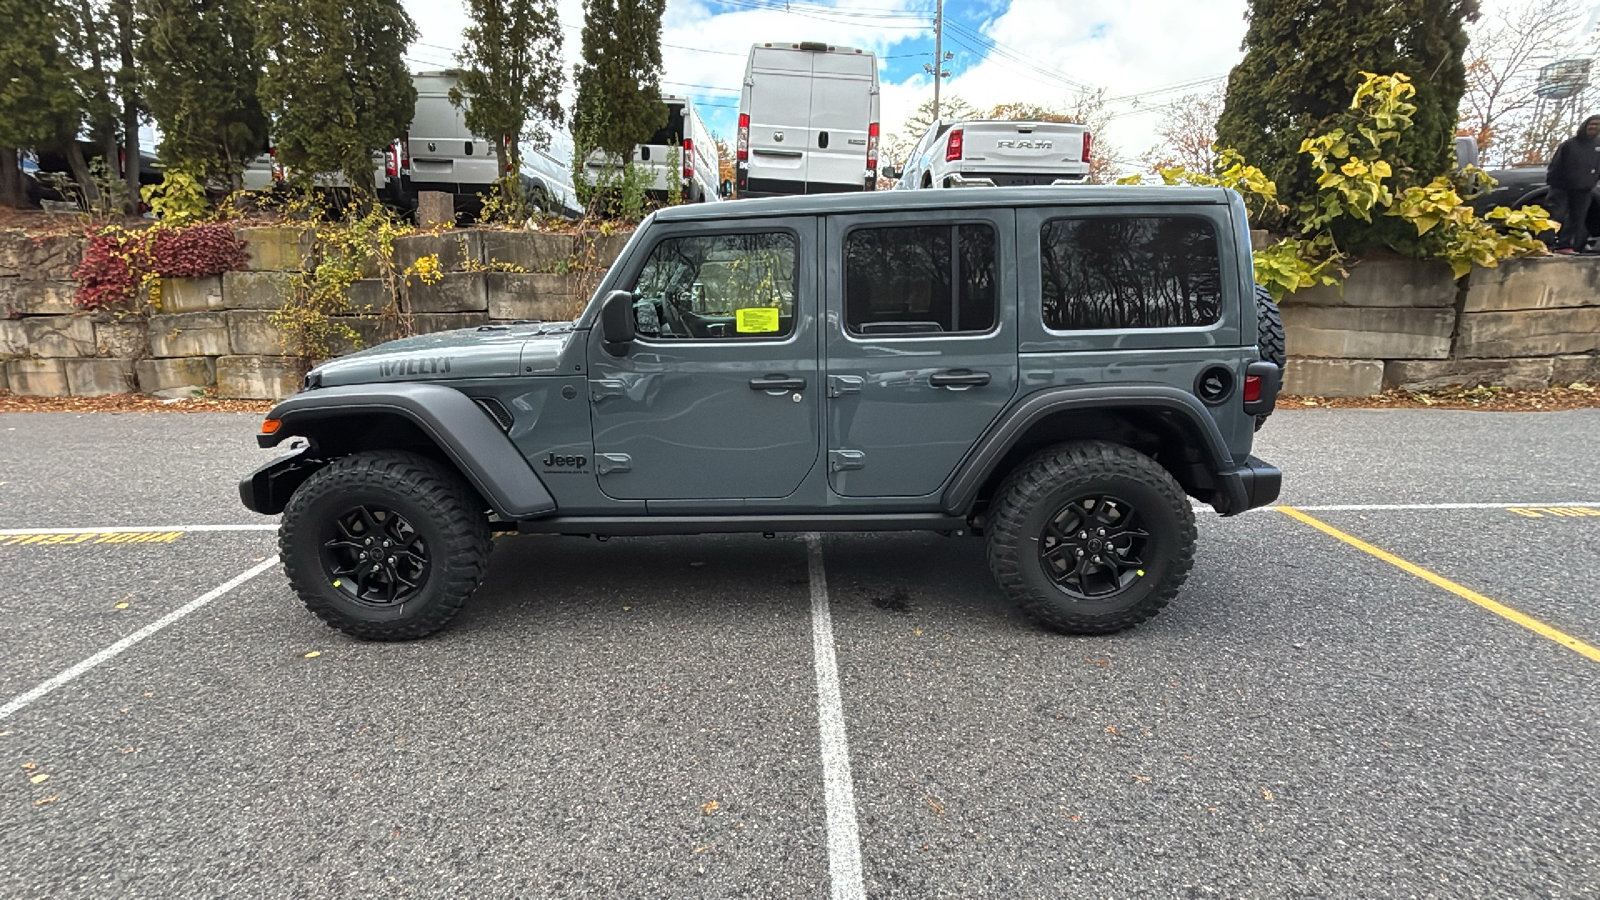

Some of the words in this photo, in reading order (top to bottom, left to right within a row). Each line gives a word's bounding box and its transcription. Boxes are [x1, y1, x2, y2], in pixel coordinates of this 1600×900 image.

[997, 139, 1053, 149] RAM
[379, 357, 454, 377] WILLYS
[543, 451, 588, 469] Jeep
